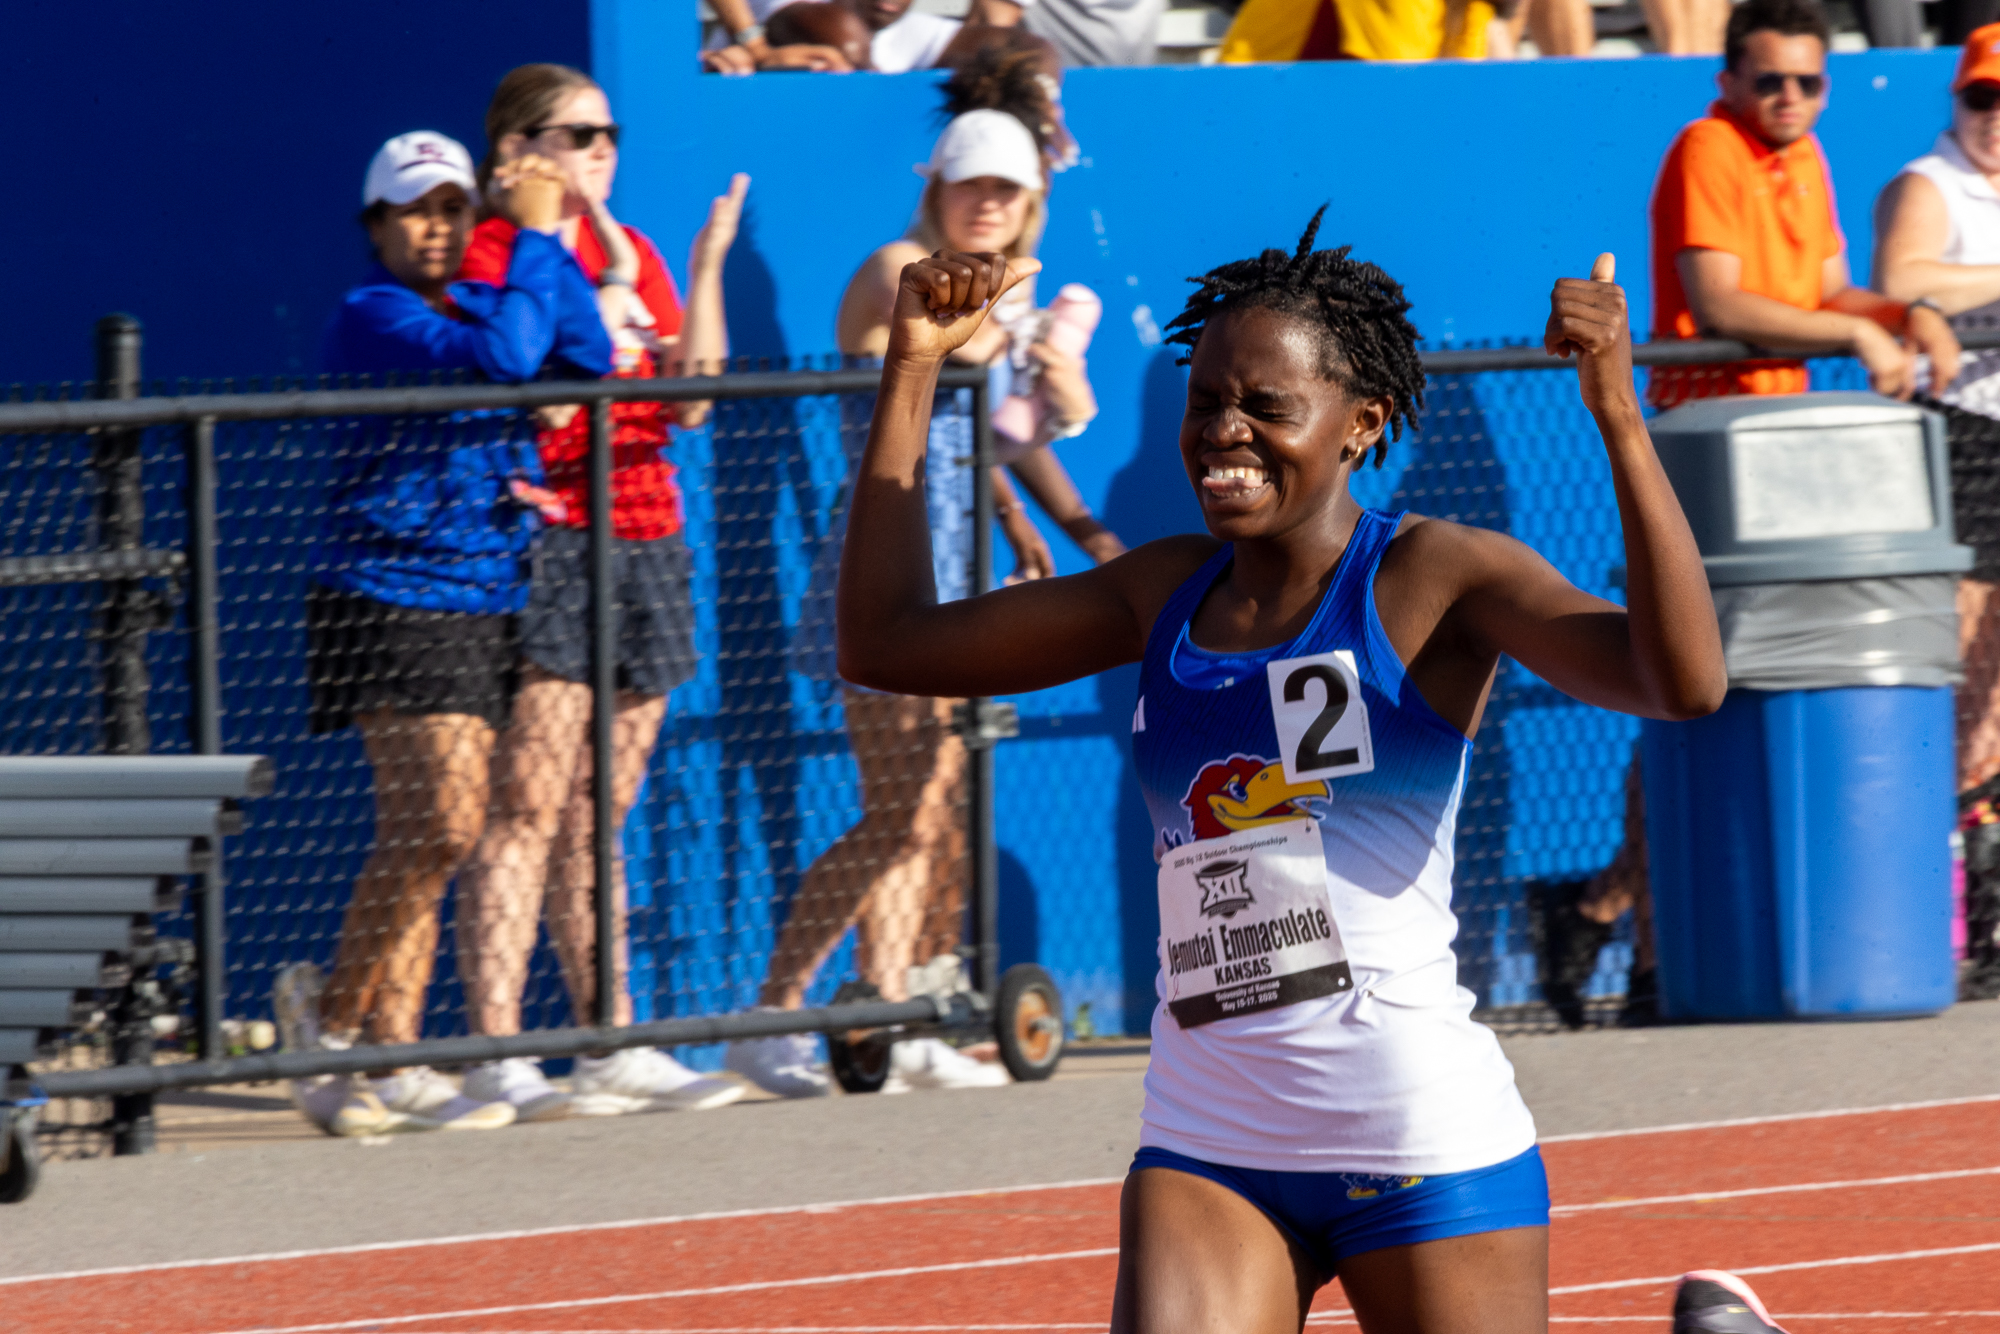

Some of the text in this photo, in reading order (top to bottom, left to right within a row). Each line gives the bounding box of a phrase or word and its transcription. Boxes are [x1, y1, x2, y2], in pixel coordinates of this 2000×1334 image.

[1284, 664, 1359, 774] 2
[1229, 836, 1288, 853] Championships
[1168, 907, 1331, 976] Jemutai Emmaculate
[1214, 958, 1272, 986] KANSAS
[1222, 1001, 1236, 1012] May
